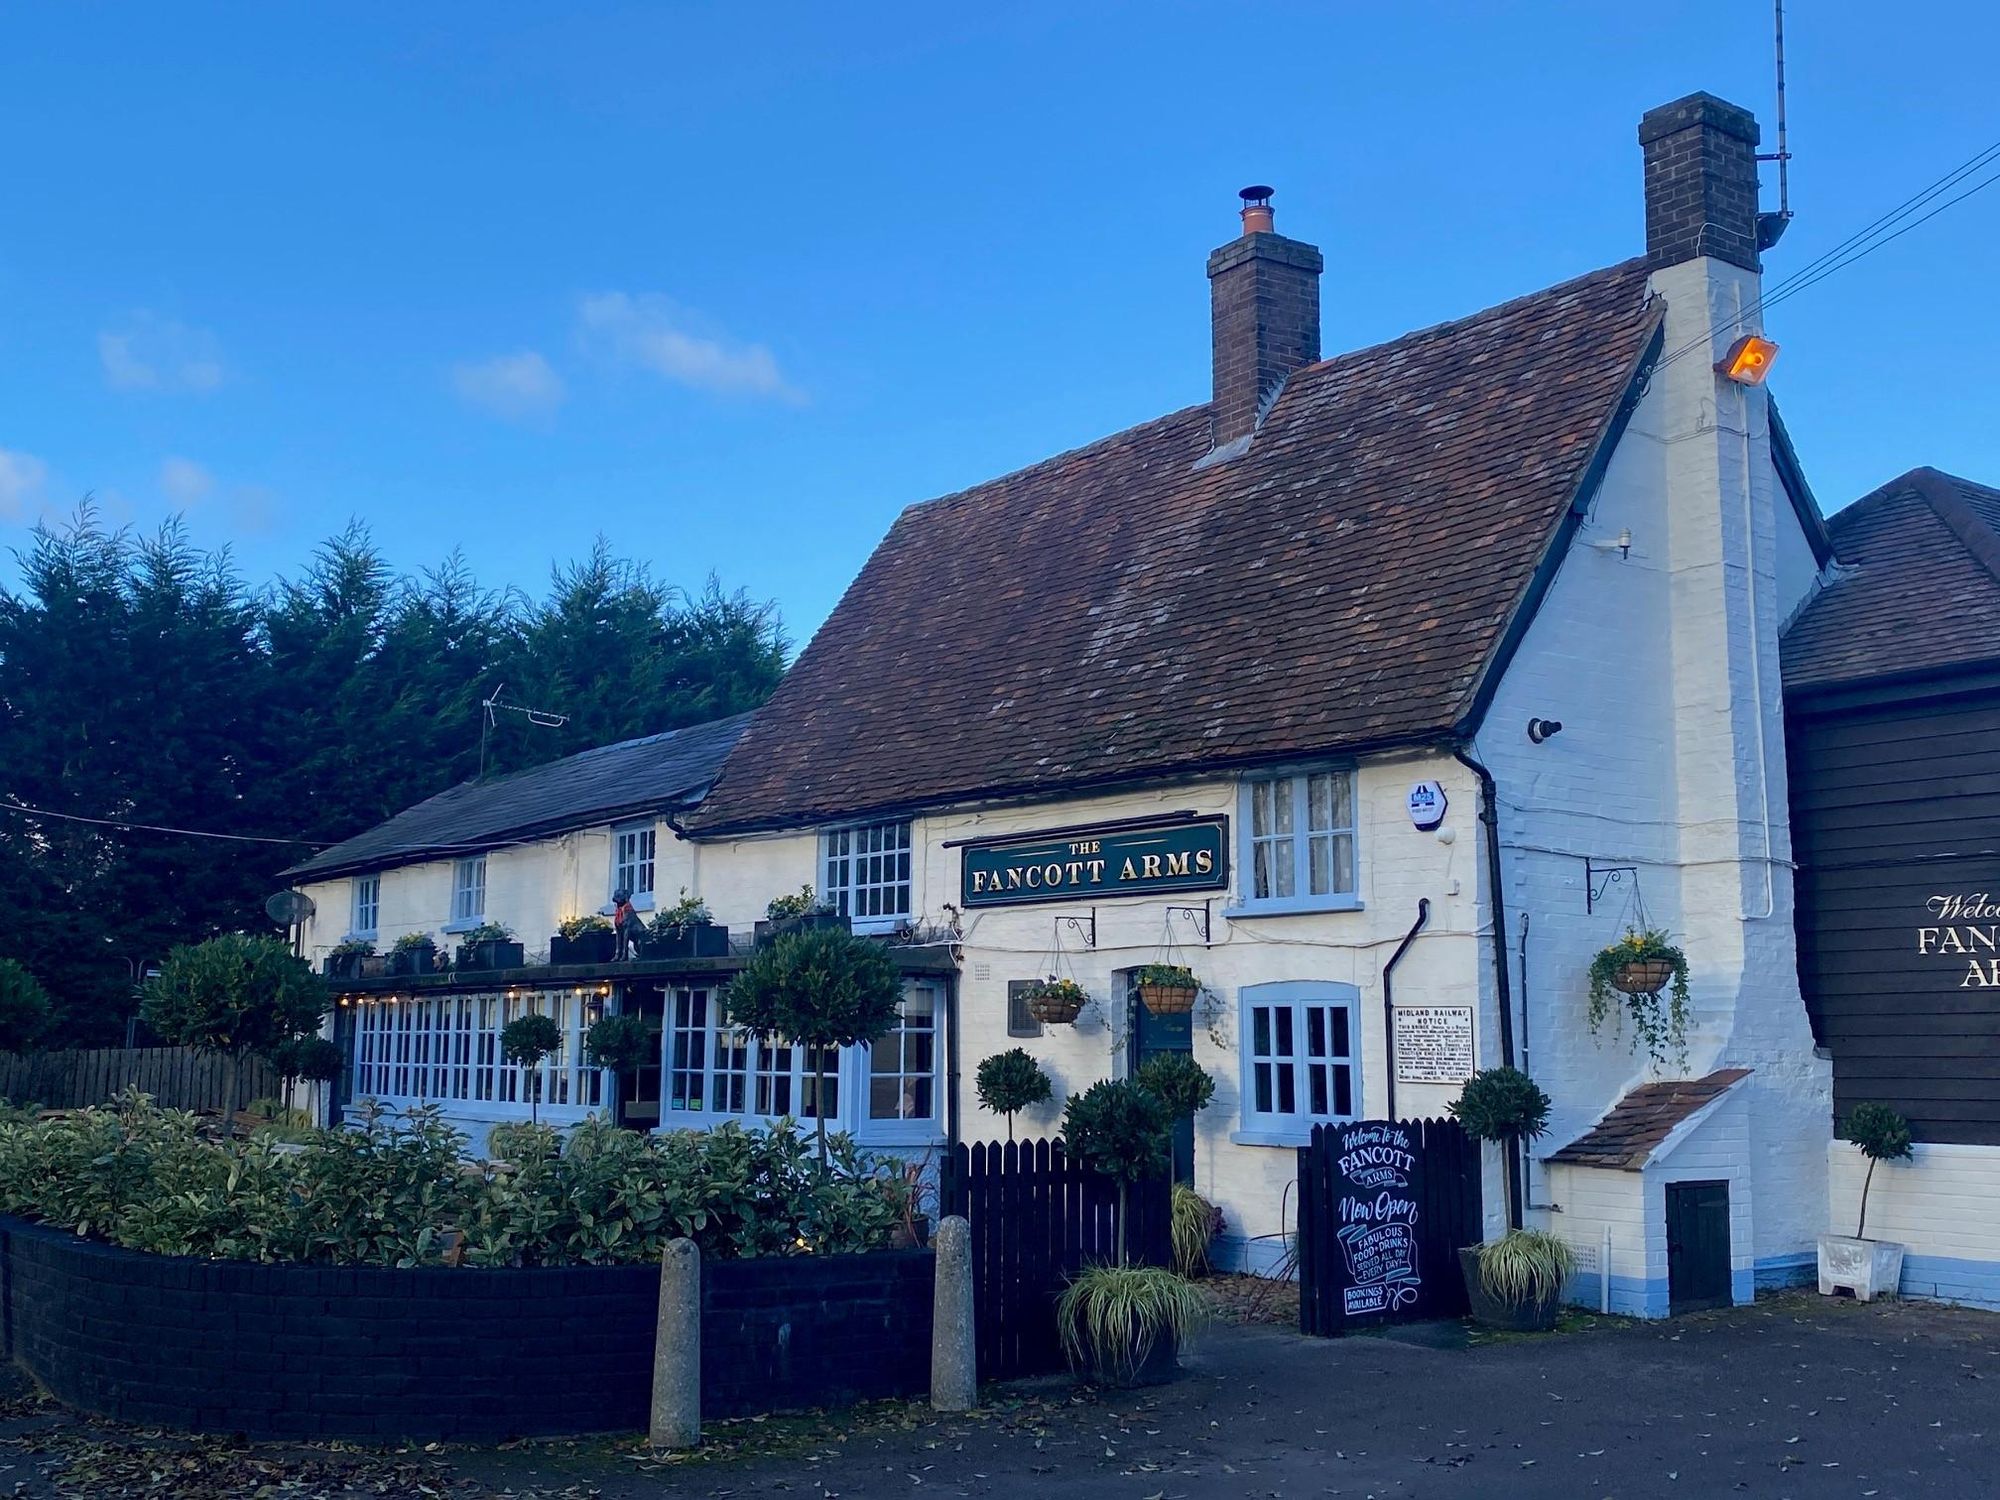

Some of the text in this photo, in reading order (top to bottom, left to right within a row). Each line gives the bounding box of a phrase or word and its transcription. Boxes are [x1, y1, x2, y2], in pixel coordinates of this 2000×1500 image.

[1069, 840, 1100, 856] THE
[972, 849, 1214, 893] FANCOTT ARMS
[1918, 925, 2000, 954] FAN
[1342, 1127, 1380, 1151] Welcome
[1391, 1130, 1410, 1149] the
[1338, 1146, 1415, 1176] FANCOTT
[1367, 1169, 1393, 1186] ARMS
[1339, 1191, 1418, 1225] Now Open
[1358, 1227, 1403, 1250] FABULOUS
[1357, 1255, 1380, 1272] SERVED
[1381, 1250, 1393, 1262] ALL
[1347, 1286, 1383, 1300] BOOKINGS
[1348, 1296, 1382, 1311] AVAILABLE
